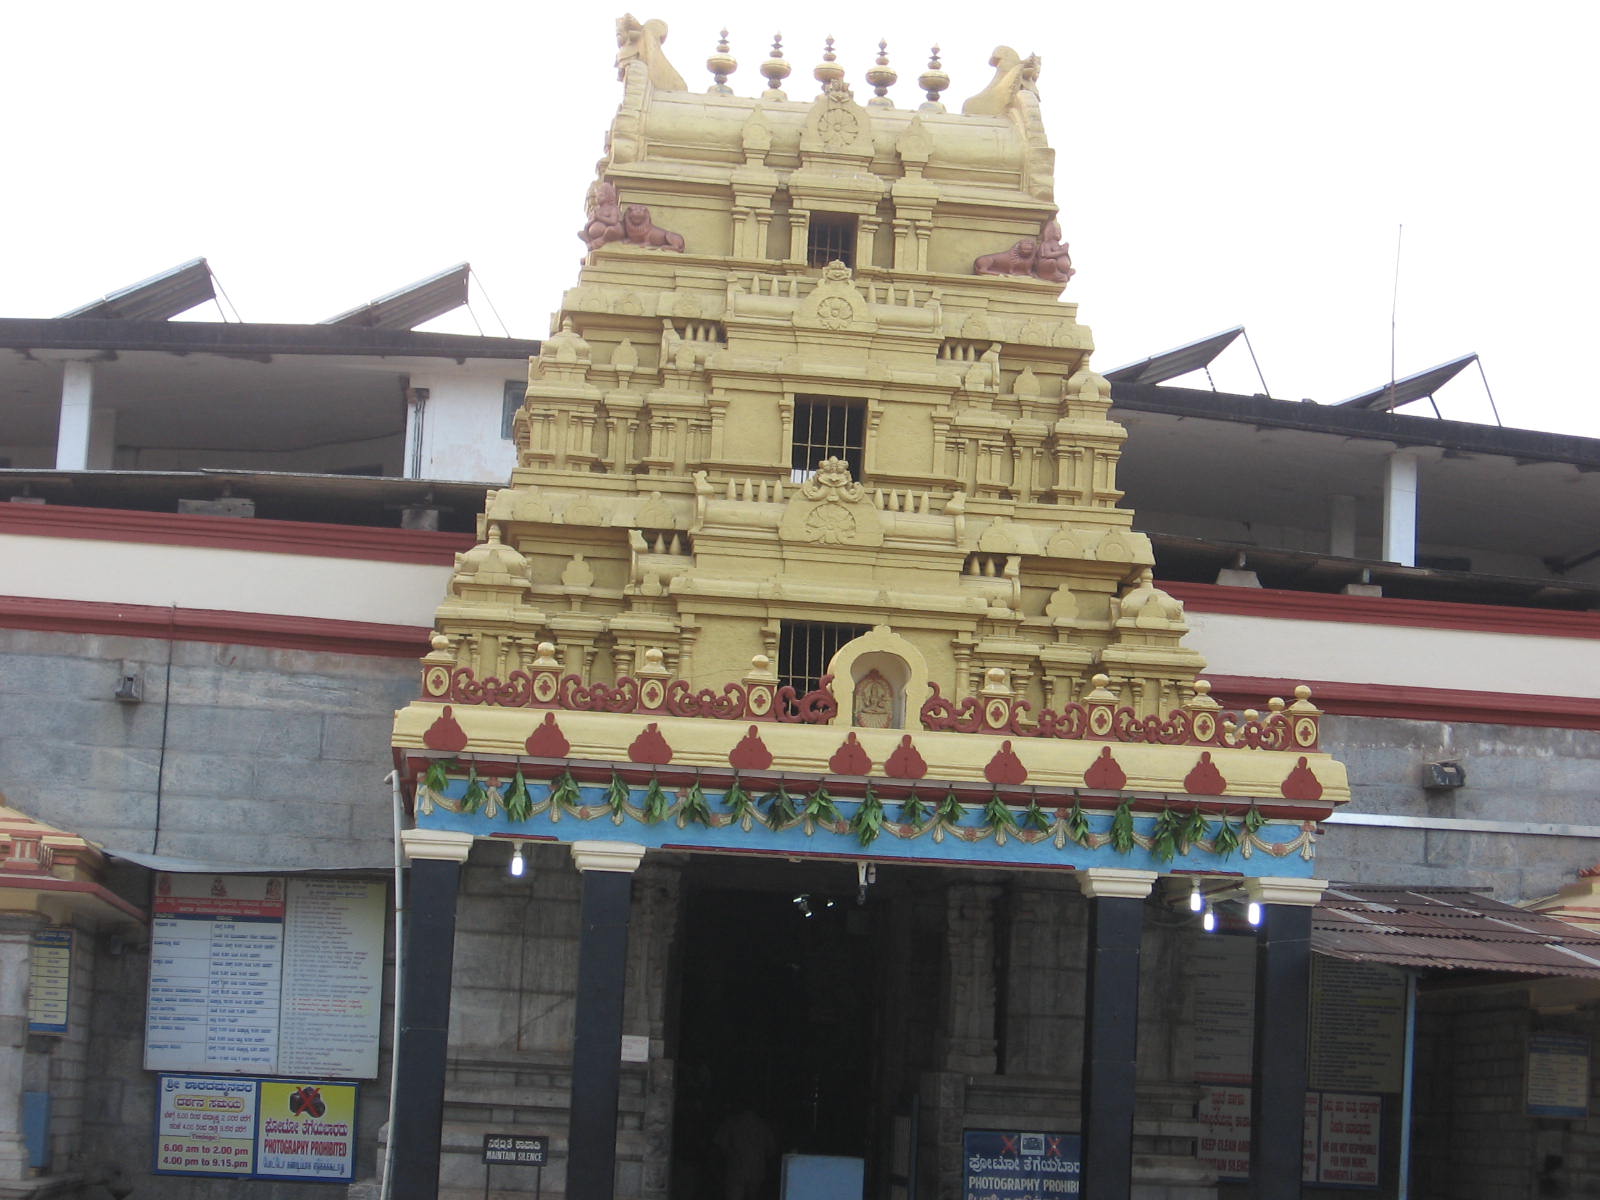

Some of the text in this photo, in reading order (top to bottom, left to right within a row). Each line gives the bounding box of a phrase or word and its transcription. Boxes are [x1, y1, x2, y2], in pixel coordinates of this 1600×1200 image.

[163, 1143, 183, 1152] 6.00
[202, 1145, 210, 1153] to
[213, 1146, 232, 1154] 2.00
[234, 1148, 249, 1156] pm
[264, 1139, 347, 1157] PHOTOGRAPHY PROHIBITED
[163, 1156, 182, 1164] 4.00
[184, 1159, 198, 1167] pm
[201, 1157, 210, 1166] to
[486, 1150, 543, 1162] MAINTAIN SILENCE
[1023, 1156, 1080, 1173] ತೆಗೆಯಬಾರ
[968, 1176, 1080, 1193] PHOTOGRAPHY PROHIBI
